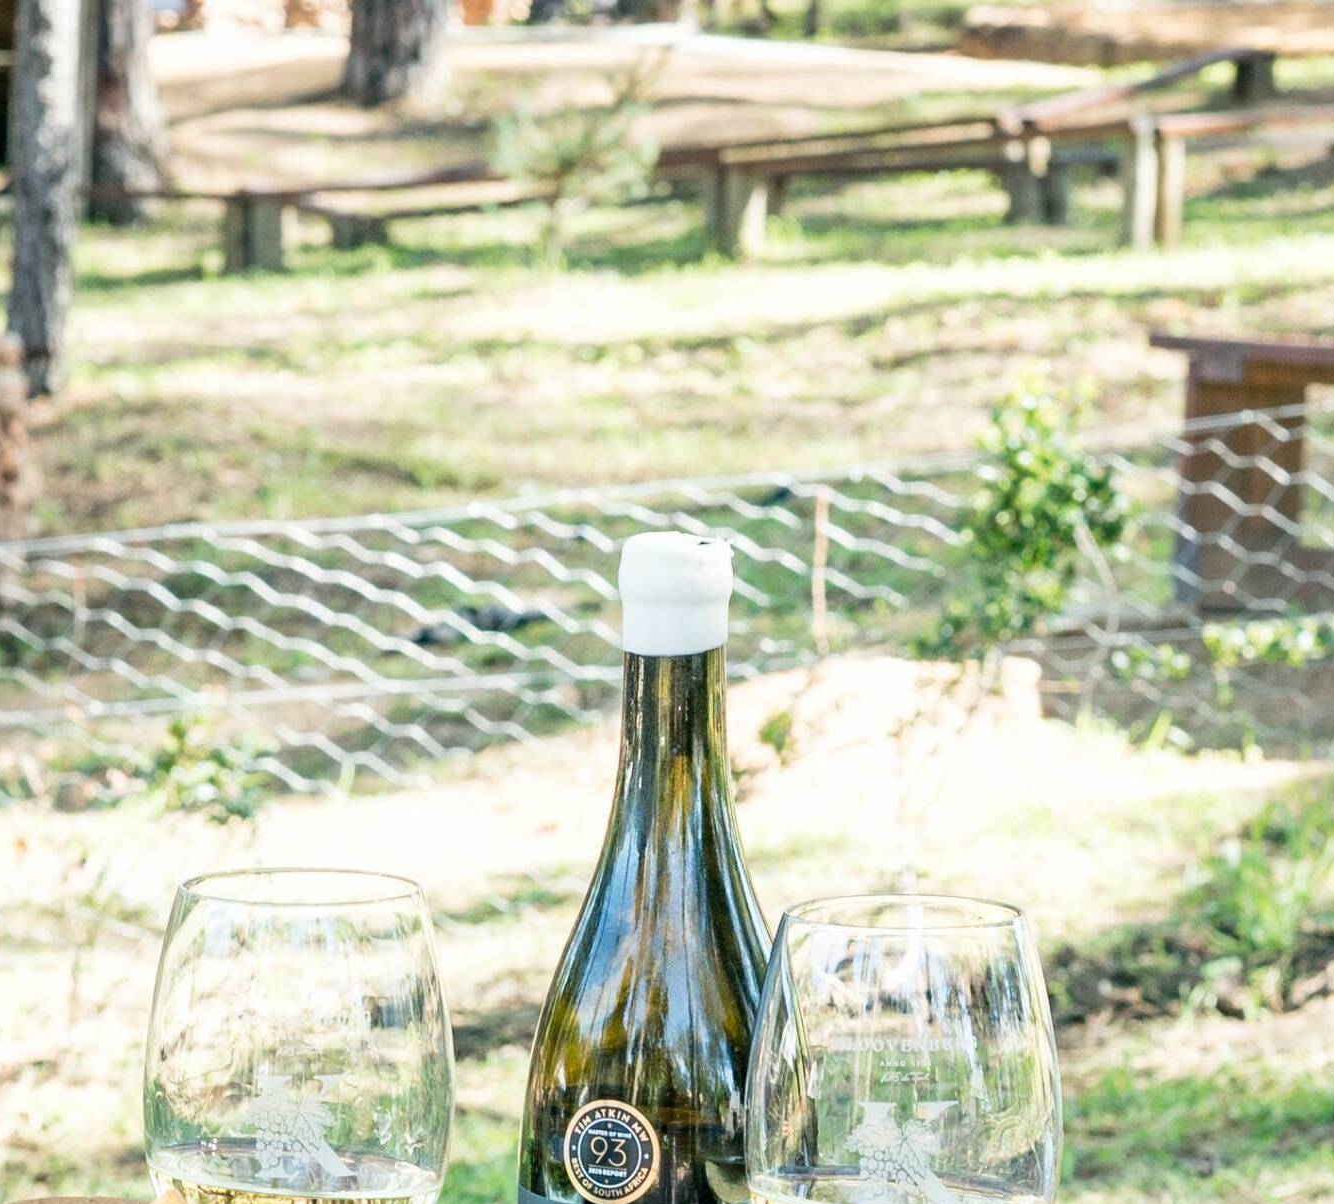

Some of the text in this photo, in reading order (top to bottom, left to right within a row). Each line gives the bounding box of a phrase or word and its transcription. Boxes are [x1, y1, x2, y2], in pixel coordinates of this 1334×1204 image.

[575, 1109, 649, 1142] TIM ATKIN MW
[590, 1136, 627, 1167] 93
[571, 1157, 649, 1198] BEST OF SOUTH AFRICA
[603, 1169, 627, 1177] REPORT
